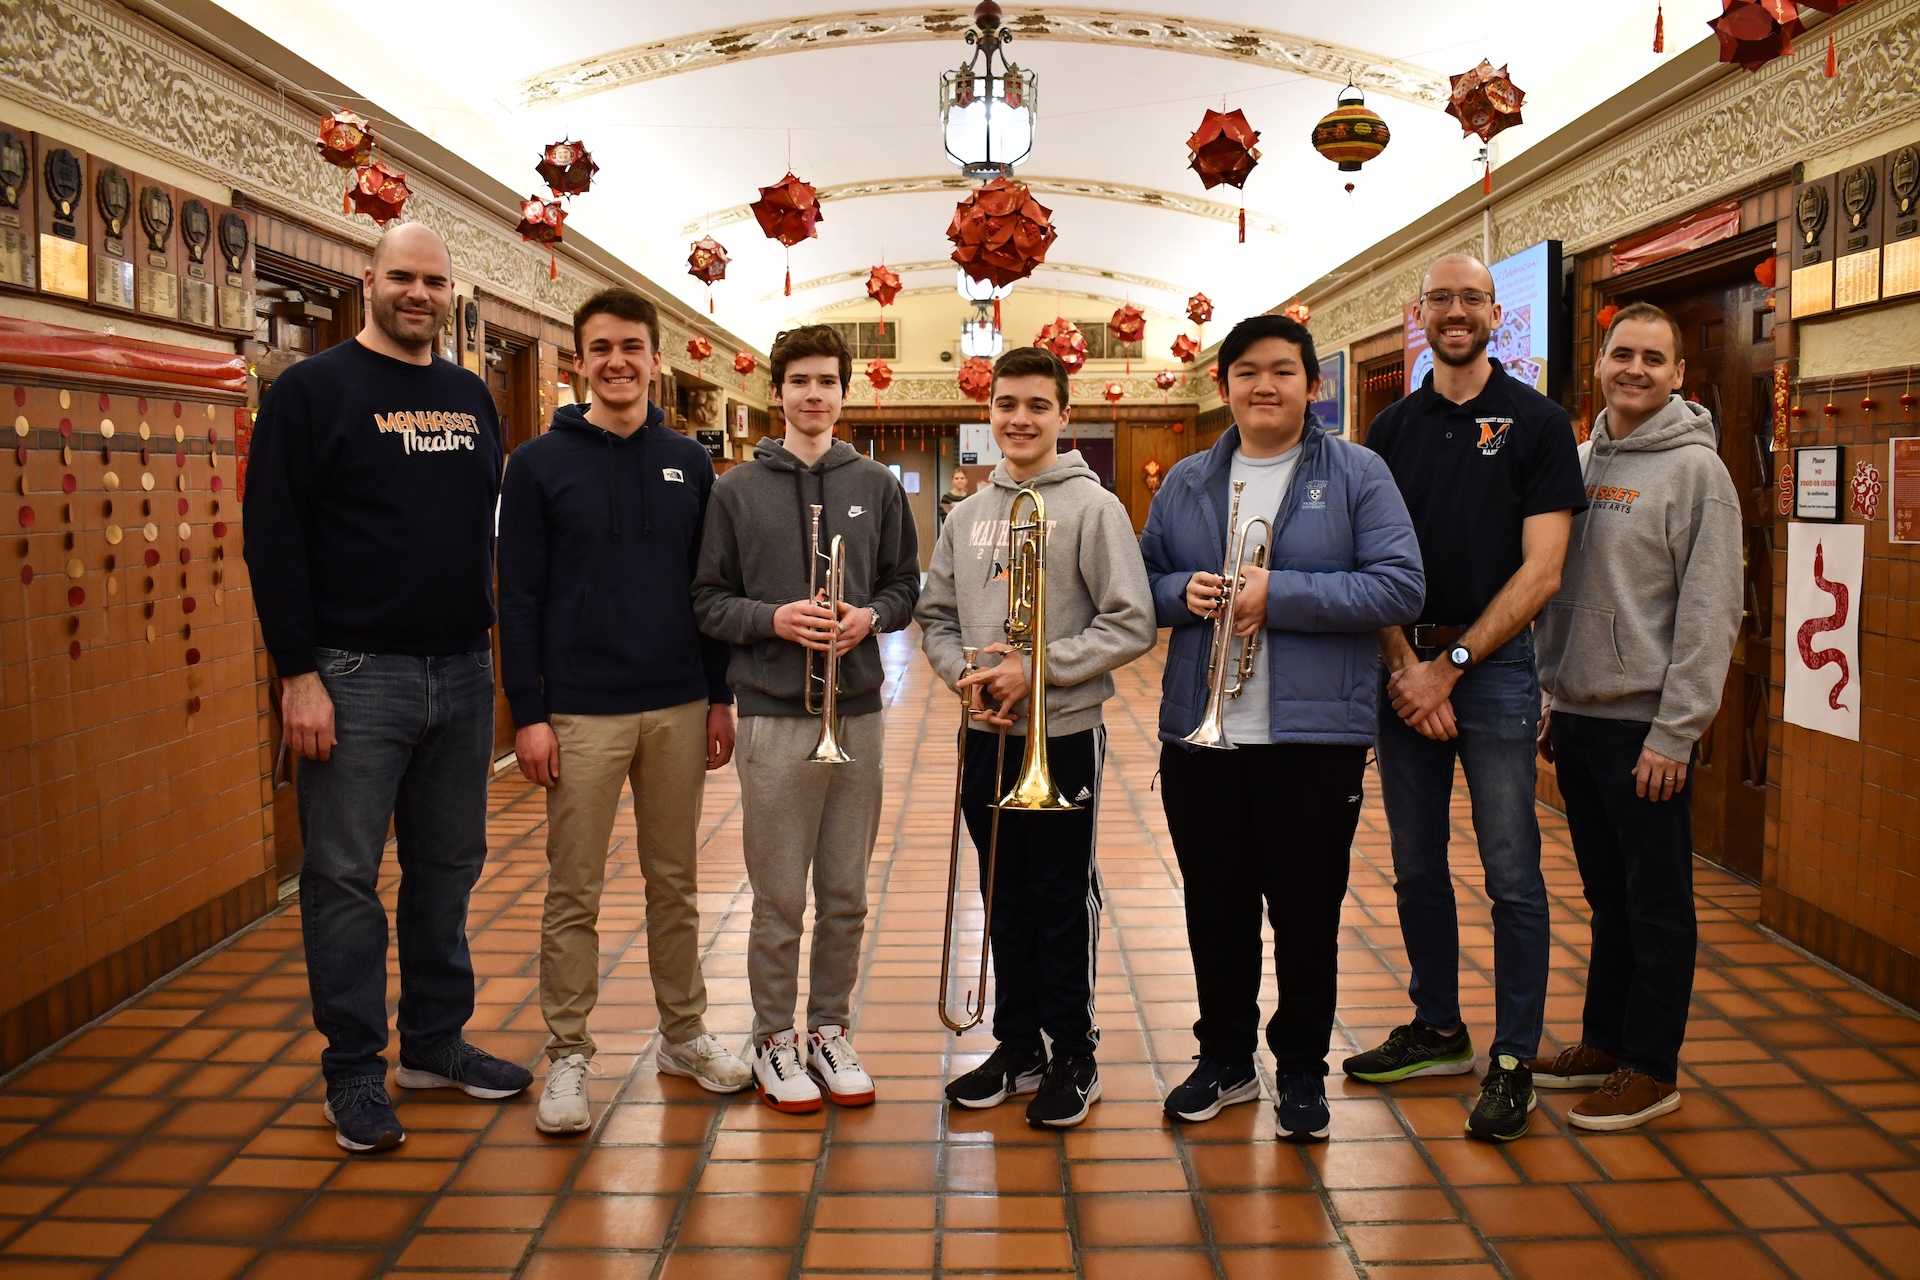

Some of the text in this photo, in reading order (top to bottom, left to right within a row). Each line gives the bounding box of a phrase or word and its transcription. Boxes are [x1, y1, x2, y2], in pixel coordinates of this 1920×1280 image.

[374, 411, 480, 434] MANHASSET
[402, 429, 475, 455] Theatre
[1586, 485, 1640, 504] ASSET
[1608, 503, 1631, 514] ARTS
